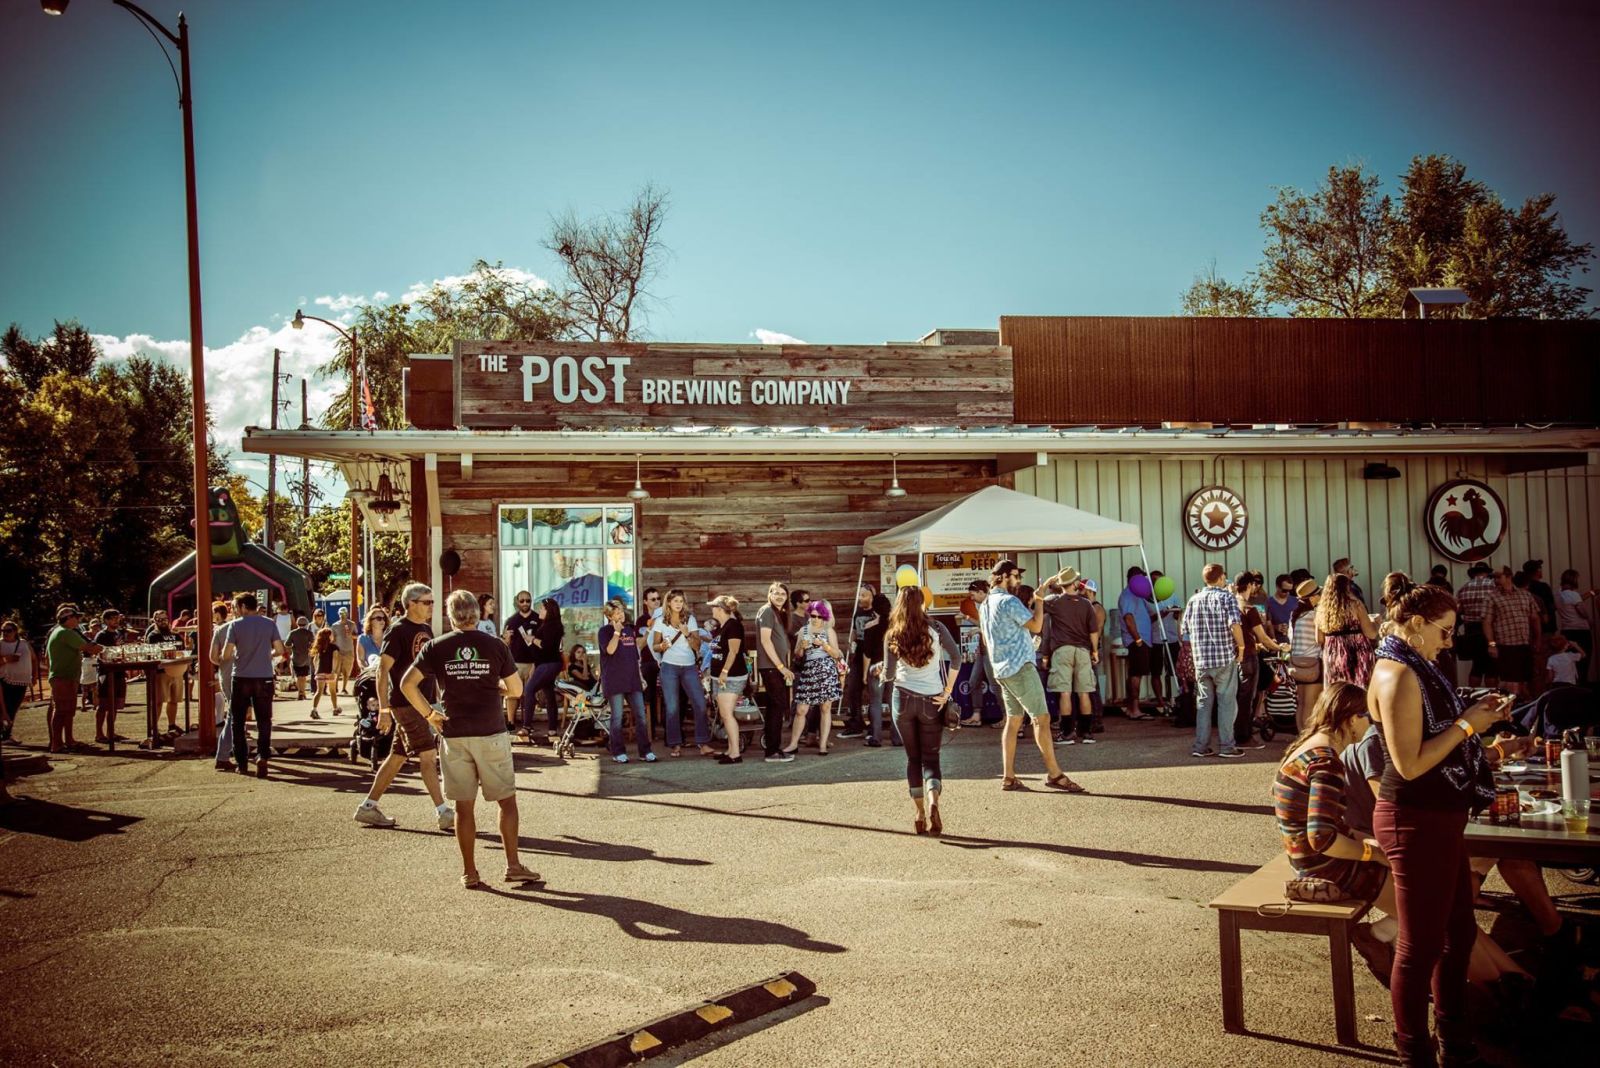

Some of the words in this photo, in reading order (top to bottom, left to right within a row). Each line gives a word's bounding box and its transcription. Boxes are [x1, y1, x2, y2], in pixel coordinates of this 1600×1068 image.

[478, 354, 508, 372] THE
[519, 355, 631, 404] POST
[642, 379, 742, 405] BREWING
[751, 380, 851, 405] COMPANY
[971, 558, 996, 570] BEER
[444, 662, 469, 671] Foxtail
